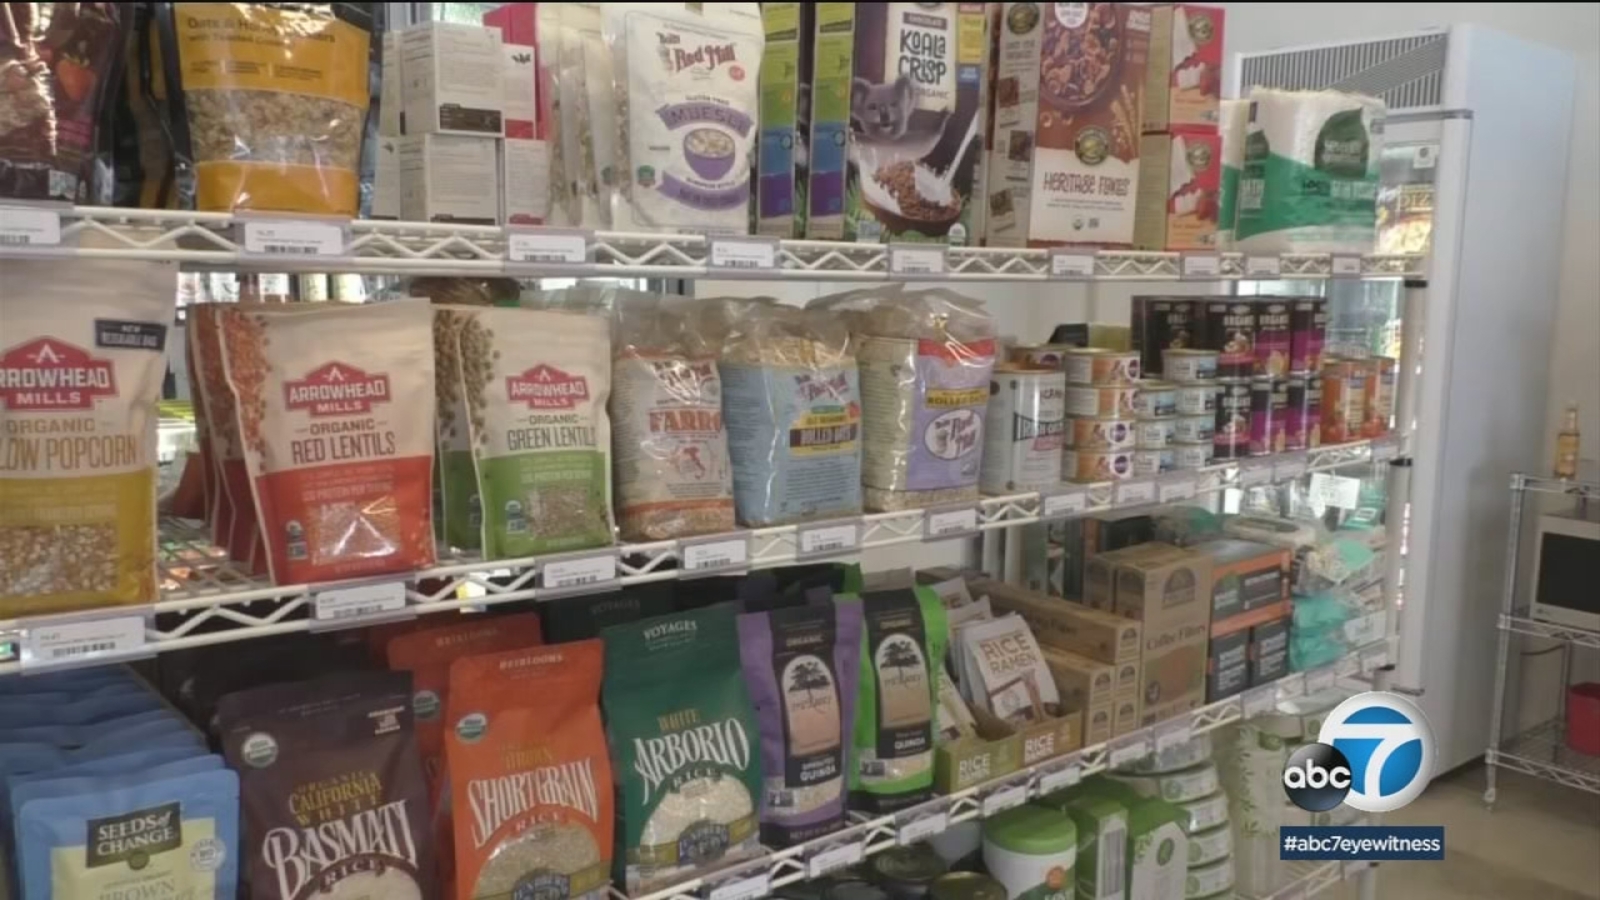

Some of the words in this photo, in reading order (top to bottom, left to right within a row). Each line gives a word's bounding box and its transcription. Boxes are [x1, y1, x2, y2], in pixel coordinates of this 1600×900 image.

[15, 391, 81, 405] MILLS
[289, 379, 387, 404] ARROWHEAD
[510, 379, 586, 397] ARROWHEAD
[316, 400, 364, 414] MILLS
[533, 396, 569, 407] MILLS
[5, 416, 97, 434] ORGANIC
[309, 418, 376, 436] ORGANIC
[529, 413, 579, 426] ORGANIC
[291, 437, 326, 465] RED
[329, 430, 396, 460] LENTILS
[507, 427, 551, 451] GREEN
[45, 433, 137, 471] POPCORN
[642, 619, 698, 641] VOYAGES
[979, 631, 1031, 660] RICE
[988, 651, 1041, 675] RAMEN
[1024, 732, 1055, 757] RICE
[632, 717, 751, 806] ARBORIO
[959, 752, 991, 777] RICE
[289, 771, 383, 815] CALIFORNIA
[98, 813, 158, 841] SEEDS
[96, 826, 175, 856] CHANGE
[262, 799, 418, 900] BASMATI
